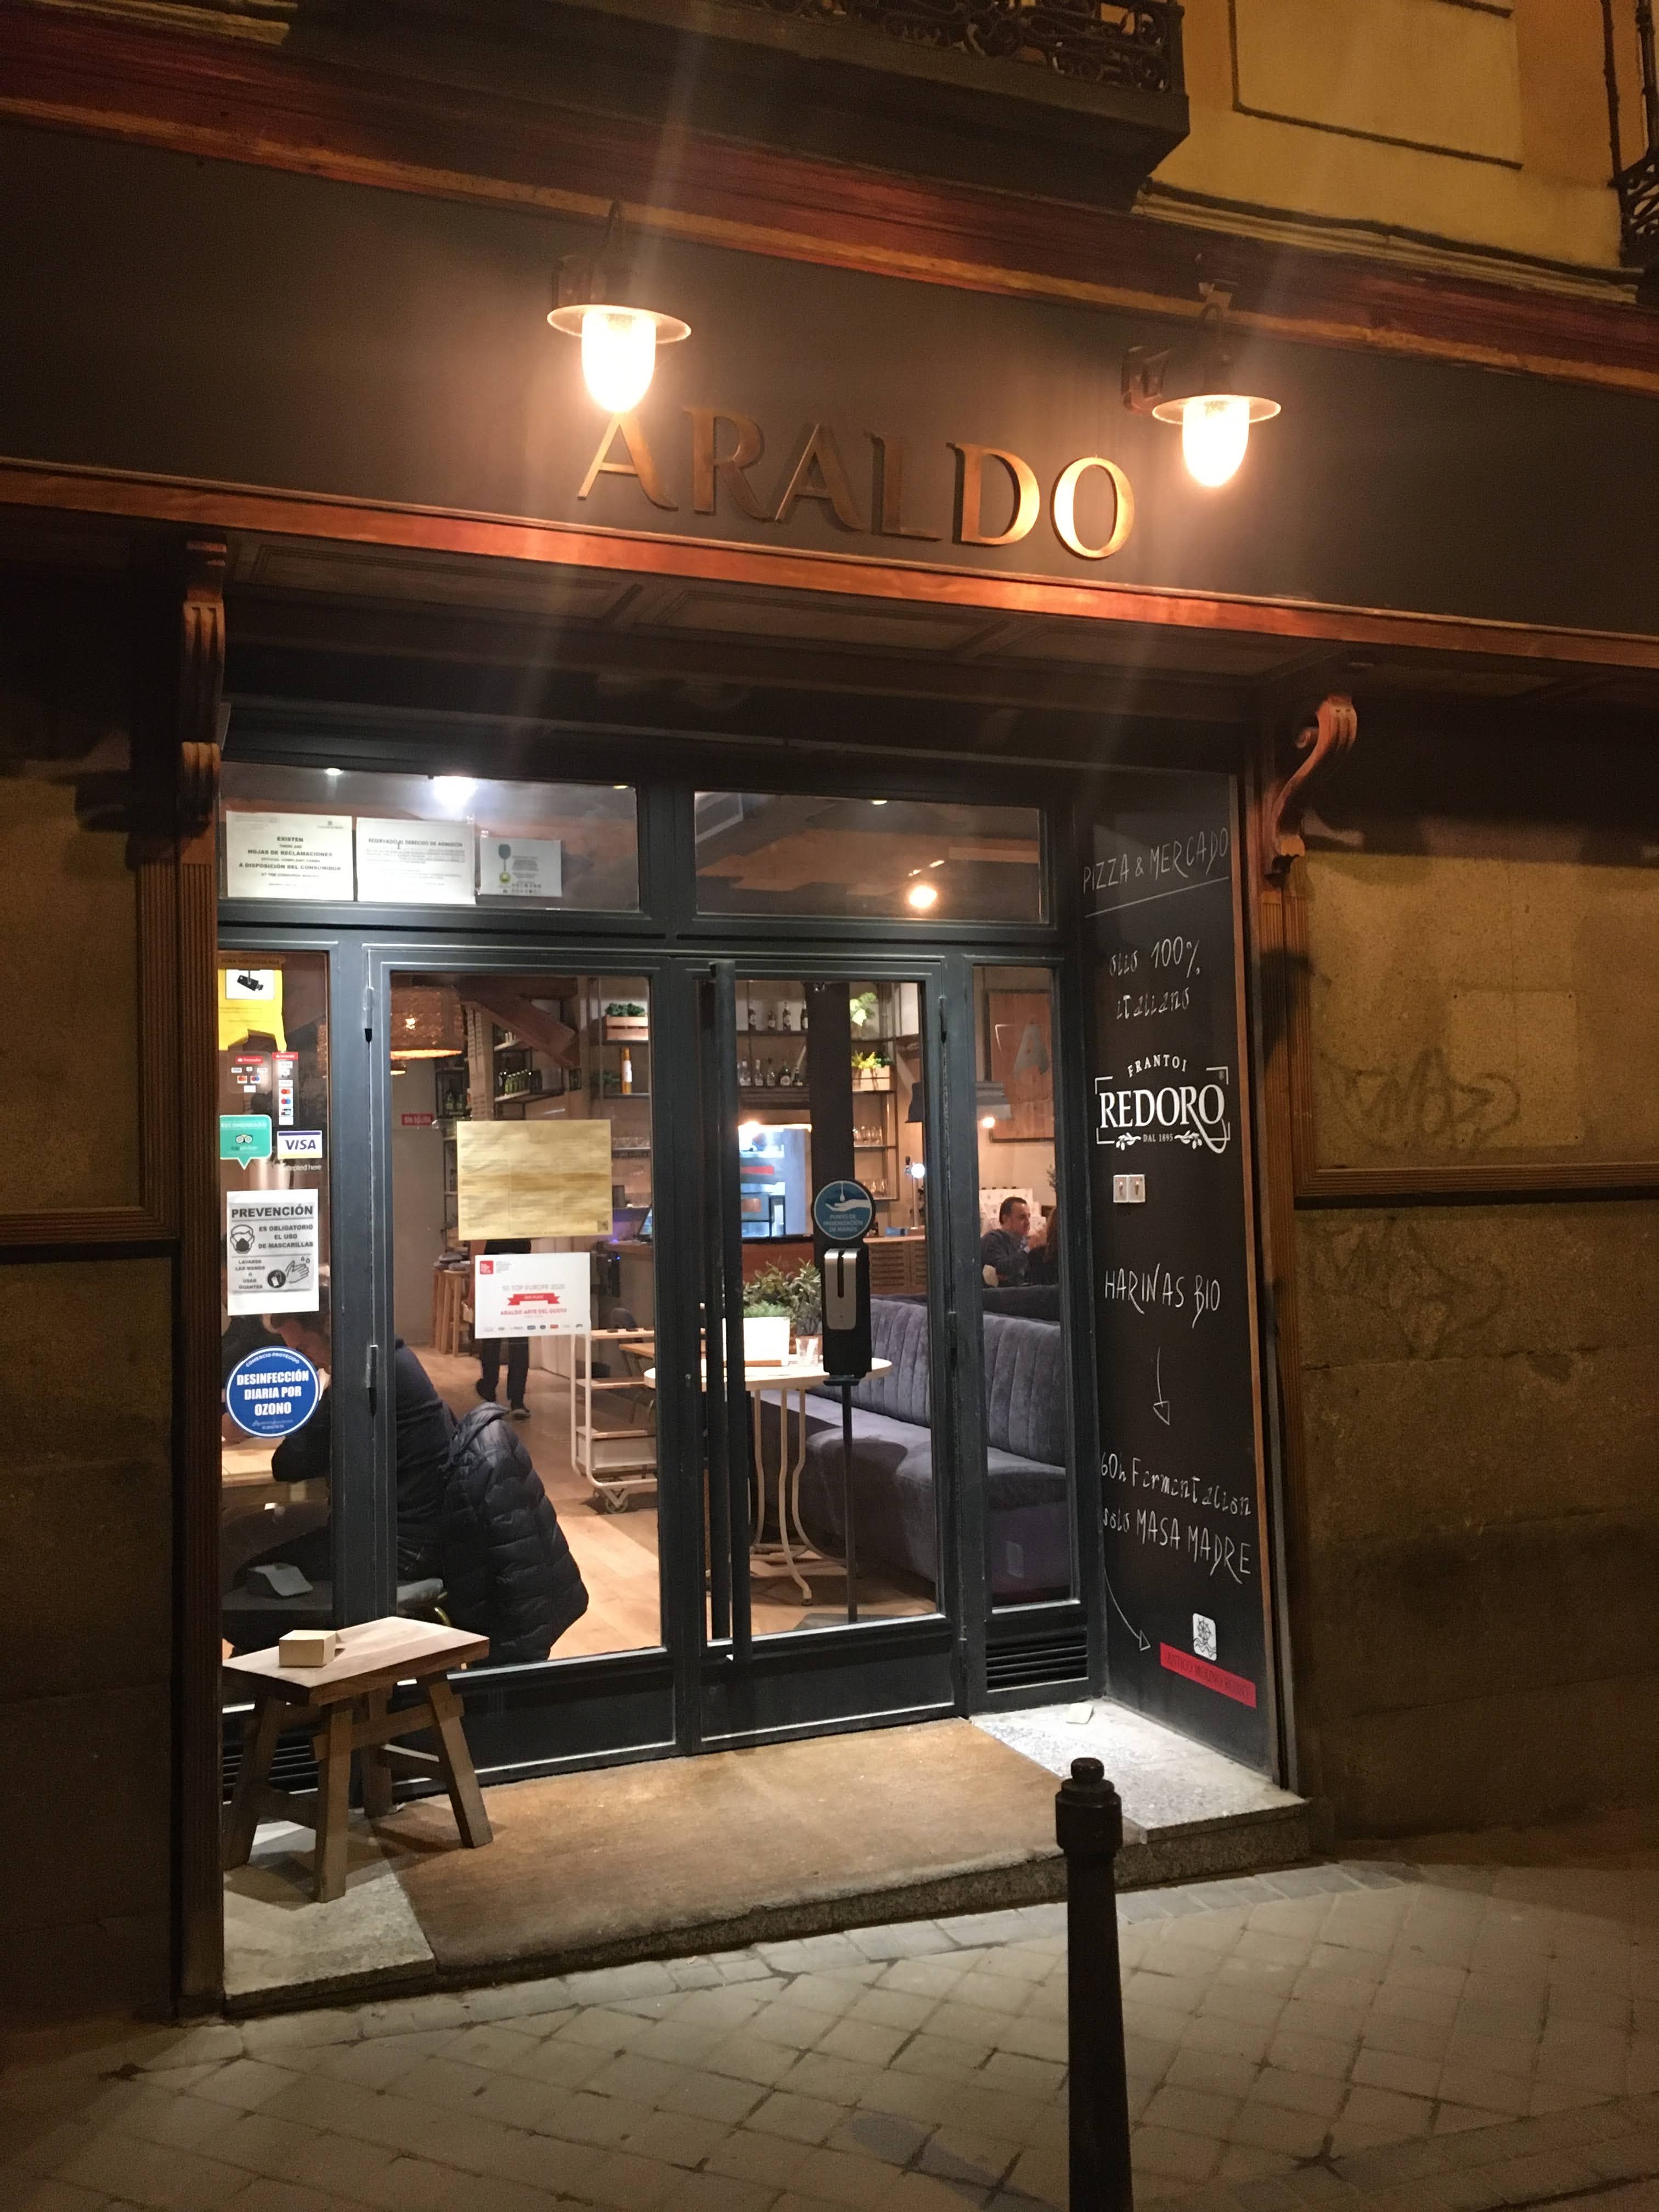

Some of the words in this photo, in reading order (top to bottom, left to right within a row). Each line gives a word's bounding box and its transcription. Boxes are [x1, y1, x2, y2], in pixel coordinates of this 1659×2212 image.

[577, 405, 1135, 558] ARALDO
[1084, 853, 1129, 894] PIZZA
[1135, 856, 1144, 877] &
[1149, 827, 1228, 881] MERCADO
[1150, 936, 1200, 978] 100%
[1127, 1054, 1187, 1078] FRANTOI
[1099, 1084, 1227, 1154] REDORO
[285, 1139, 317, 1150] VISA
[1143, 1134, 1156, 1142] DAL
[1158, 1133, 1173, 1142] 1895
[232, 1204, 313, 1218] PREVENCIÓN
[1104, 1263, 1184, 1314] HARINAS
[1191, 1274, 1220, 1329] BIO
[246, 1353, 272, 1367] COMERCIO
[272, 1352, 300, 1364] PROTEGIDO
[236, 1369, 309, 1386] DESINFECCIÓN
[244, 1387, 280, 1400] DIARIA
[281, 1386, 302, 1398] POR
[255, 1402, 292, 1417] OZONO
[1137, 1509, 1181, 1550] MASA
[1188, 1525, 1251, 1585] MADRE
